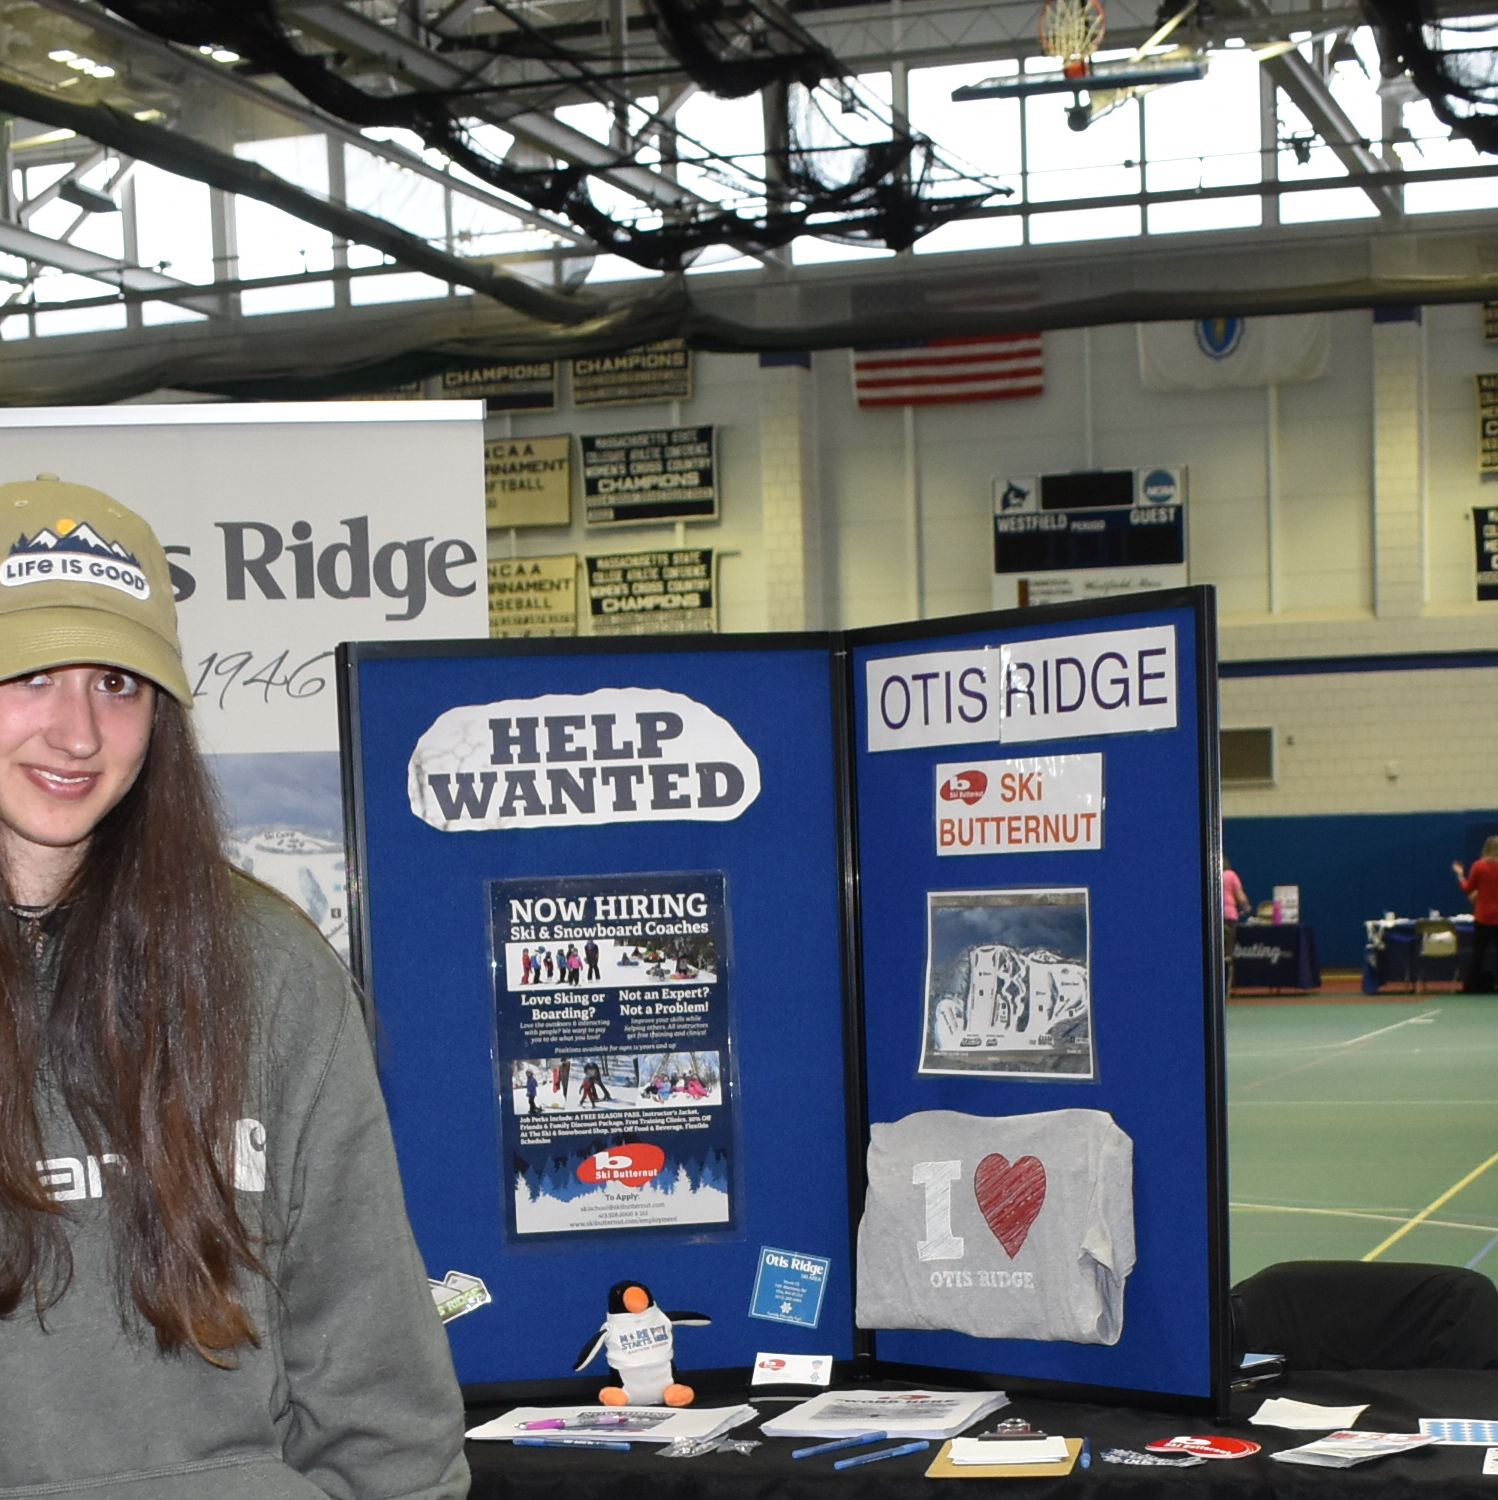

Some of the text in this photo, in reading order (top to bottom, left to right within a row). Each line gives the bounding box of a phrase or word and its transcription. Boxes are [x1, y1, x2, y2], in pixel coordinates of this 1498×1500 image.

[443, 363, 551, 385] CHAMPIONS
[575, 352, 685, 374] CHAMPIONS
[598, 472, 700, 493] CHAMPIONS
[997, 507, 1177, 533] WESTFIELD GUEST
[61, 558, 84, 577] IS
[89, 565, 147, 594] GOOD
[215, 515, 477, 622] Ridge
[488, 563, 541, 577] NCAA
[602, 592, 700, 612] CHAMPIONS
[191, 648, 337, 710] 1946
[881, 648, 1169, 730] OTIS RIDGE
[488, 711, 684, 766] HELP
[428, 761, 746, 822] WANTED
[940, 812, 1097, 848] BUTTERNUT
[509, 893, 708, 924] NOW HIRING
[511, 920, 710, 941] Ski & Snowboard Coaches
[521, 991, 606, 1007] Love Sking or
[619, 990, 642, 1001] Not
[662, 986, 711, 1001] Expert?
[532, 1006, 596, 1021] Boarding?
[620, 1004, 644, 1016] Not
[655, 1001, 710, 1014] Problem!
[595, 1168, 658, 1180] Ski Butternut
[911, 1160, 964, 1262] I
[766, 1253, 824, 1277] Otis Ridge
[930, 1269, 1035, 1290] OTIS RIDGE
